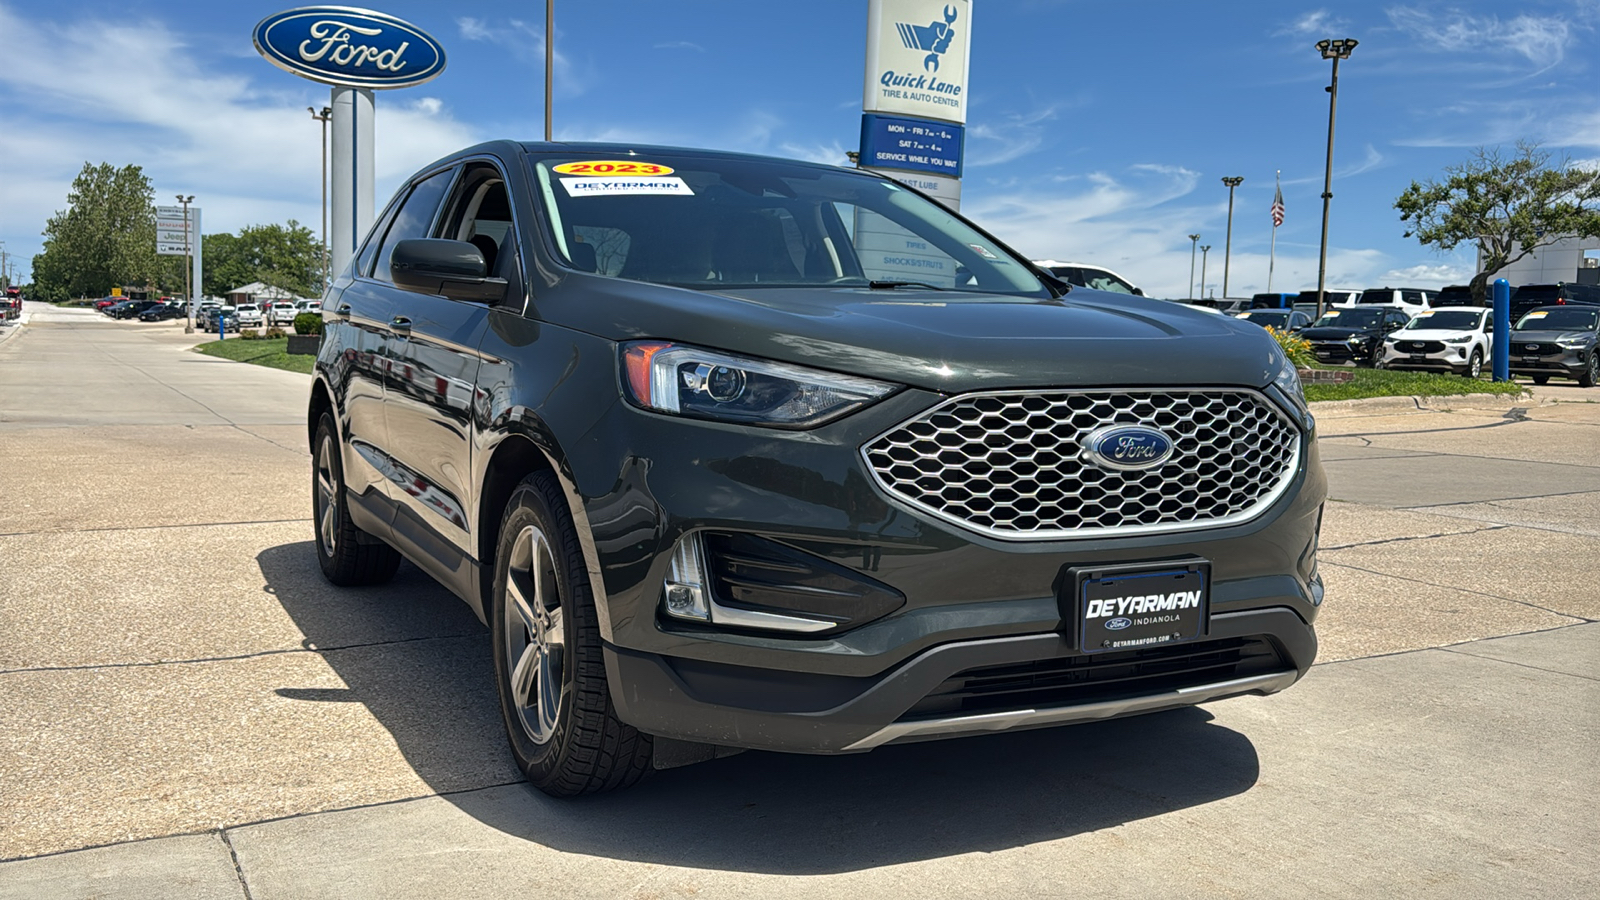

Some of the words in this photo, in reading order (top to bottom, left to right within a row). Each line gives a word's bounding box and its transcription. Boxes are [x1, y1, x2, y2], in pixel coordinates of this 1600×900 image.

[299, 20, 410, 72] Ford
[880, 70, 927, 90] Quick
[927, 77, 962, 96] Lane
[882, 89, 901, 99] TIRE
[902, 91, 908, 99] &
[910, 92, 931, 103] AUTO
[932, 96, 959, 108] CENTER
[888, 125, 905, 133] MON
[912, 127, 923, 135] FRI
[899, 140, 912, 148] SAT
[876, 152, 907, 161] SERVICE
[908, 155, 929, 164] WHILE
[930, 157, 943, 166] YOU
[944, 160, 957, 168] WAIT
[569, 164, 662, 174] 2023
[919, 181, 938, 190] LUBE
[164, 233, 186, 241] Jeep
[906, 241, 927, 249] TIRES
[884, 257, 944, 269] SHOCKS/STRUTS
[1114, 436, 1156, 458] Ford
[1086, 590, 1201, 619] DEYARMAN
[1134, 614, 1180, 626] INDIANOLA
[1112, 635, 1170, 648] DEYARMANFORD.COM
